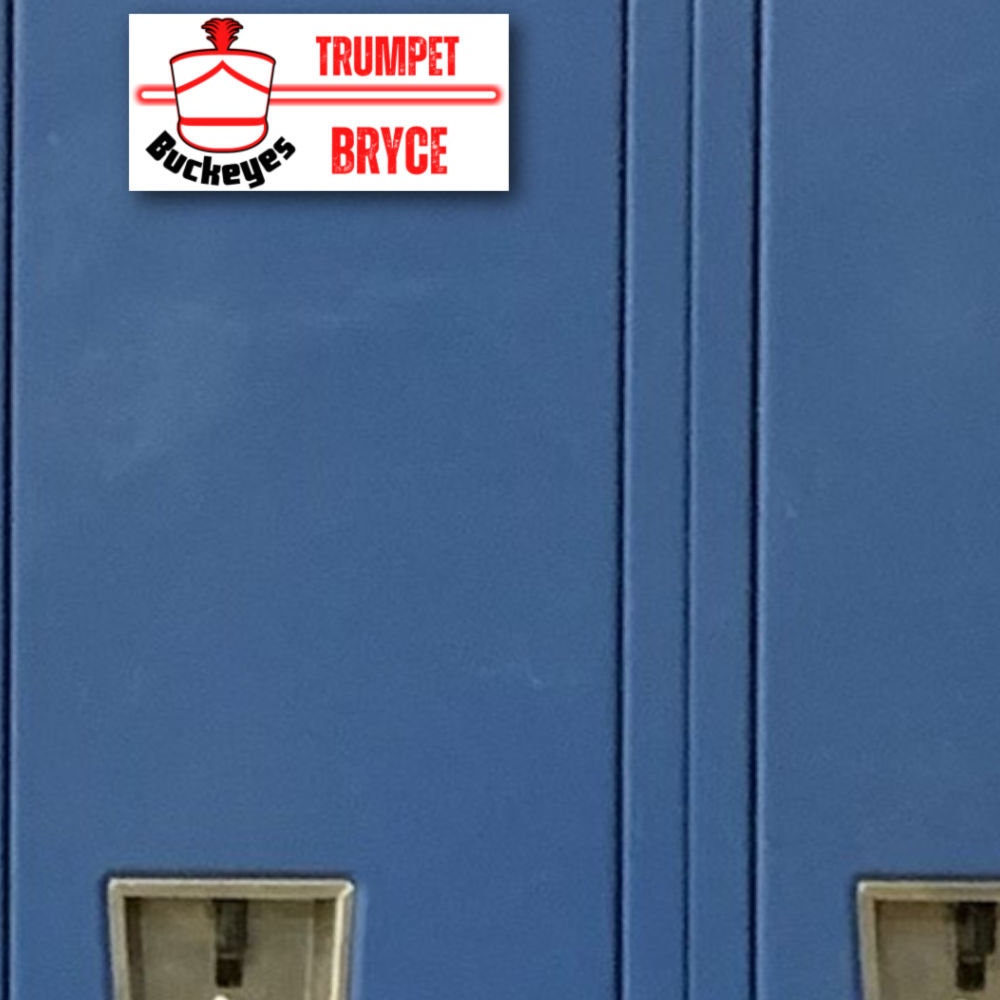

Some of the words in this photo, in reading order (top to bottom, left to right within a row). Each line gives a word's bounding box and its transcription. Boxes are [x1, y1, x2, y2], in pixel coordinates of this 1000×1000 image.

[315, 36, 460, 77] TRUMPET
[145, 130, 296, 189] Buckeyes
[331, 126, 448, 175] BRYCE
